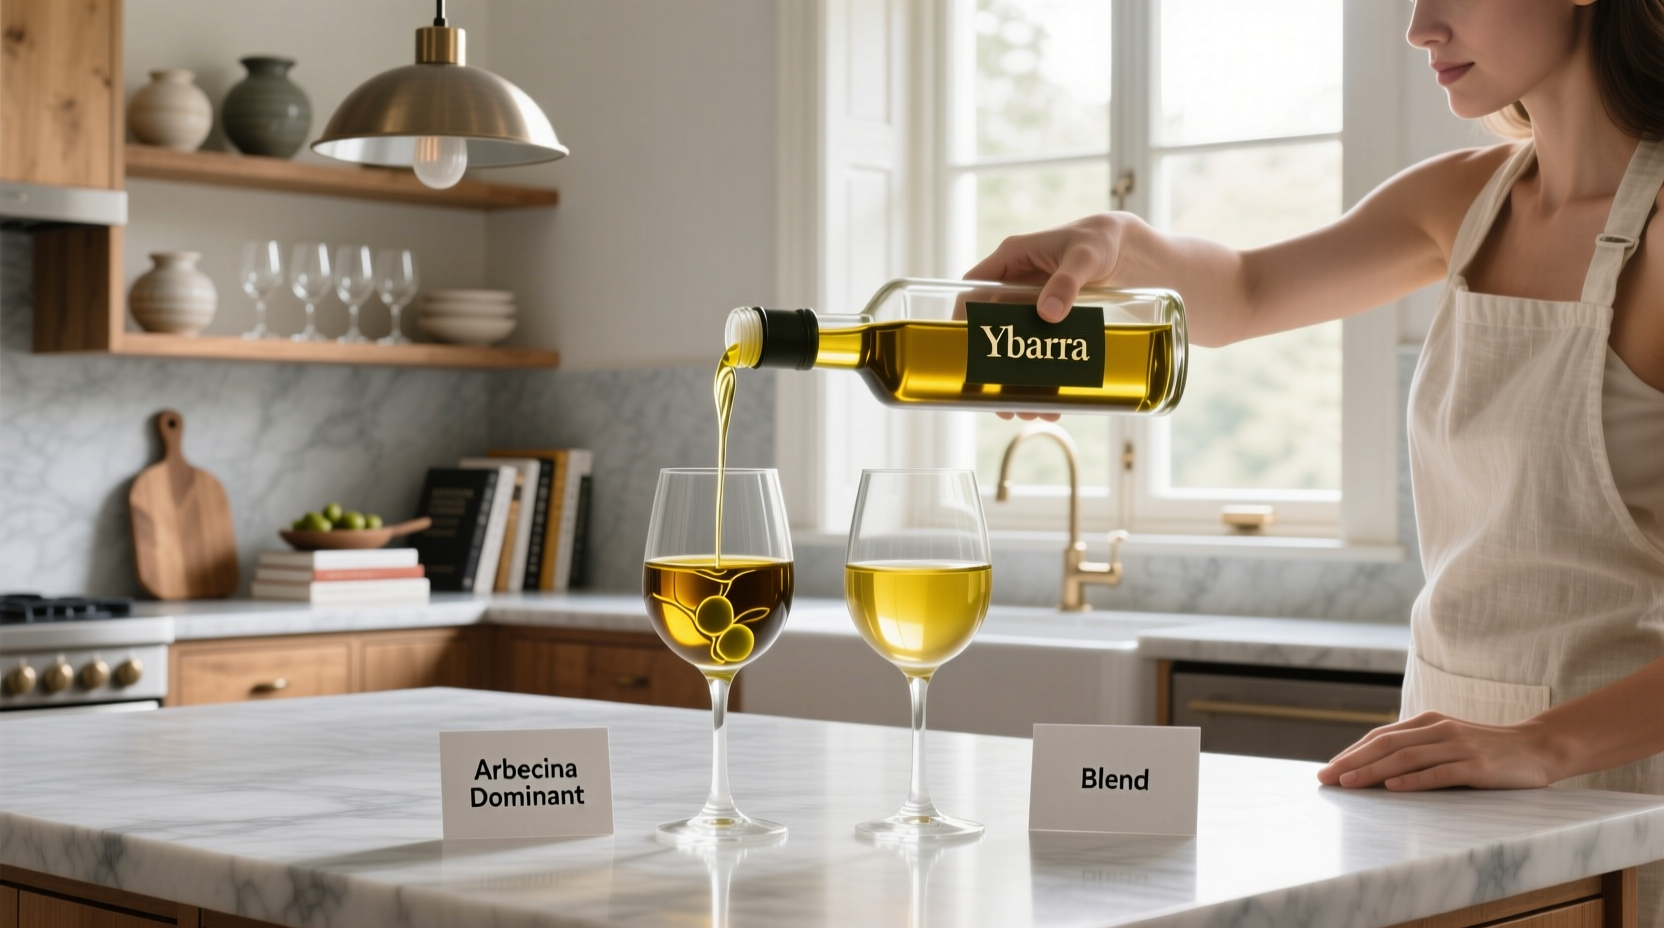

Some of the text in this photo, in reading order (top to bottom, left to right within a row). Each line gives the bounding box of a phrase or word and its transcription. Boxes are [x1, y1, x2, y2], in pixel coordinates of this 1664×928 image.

[980, 325, 1090, 361] Ybarra
[474, 757, 578, 781] Arbecina
[1081, 767, 1150, 791] Blend
[470, 785, 585, 808] Dominant
